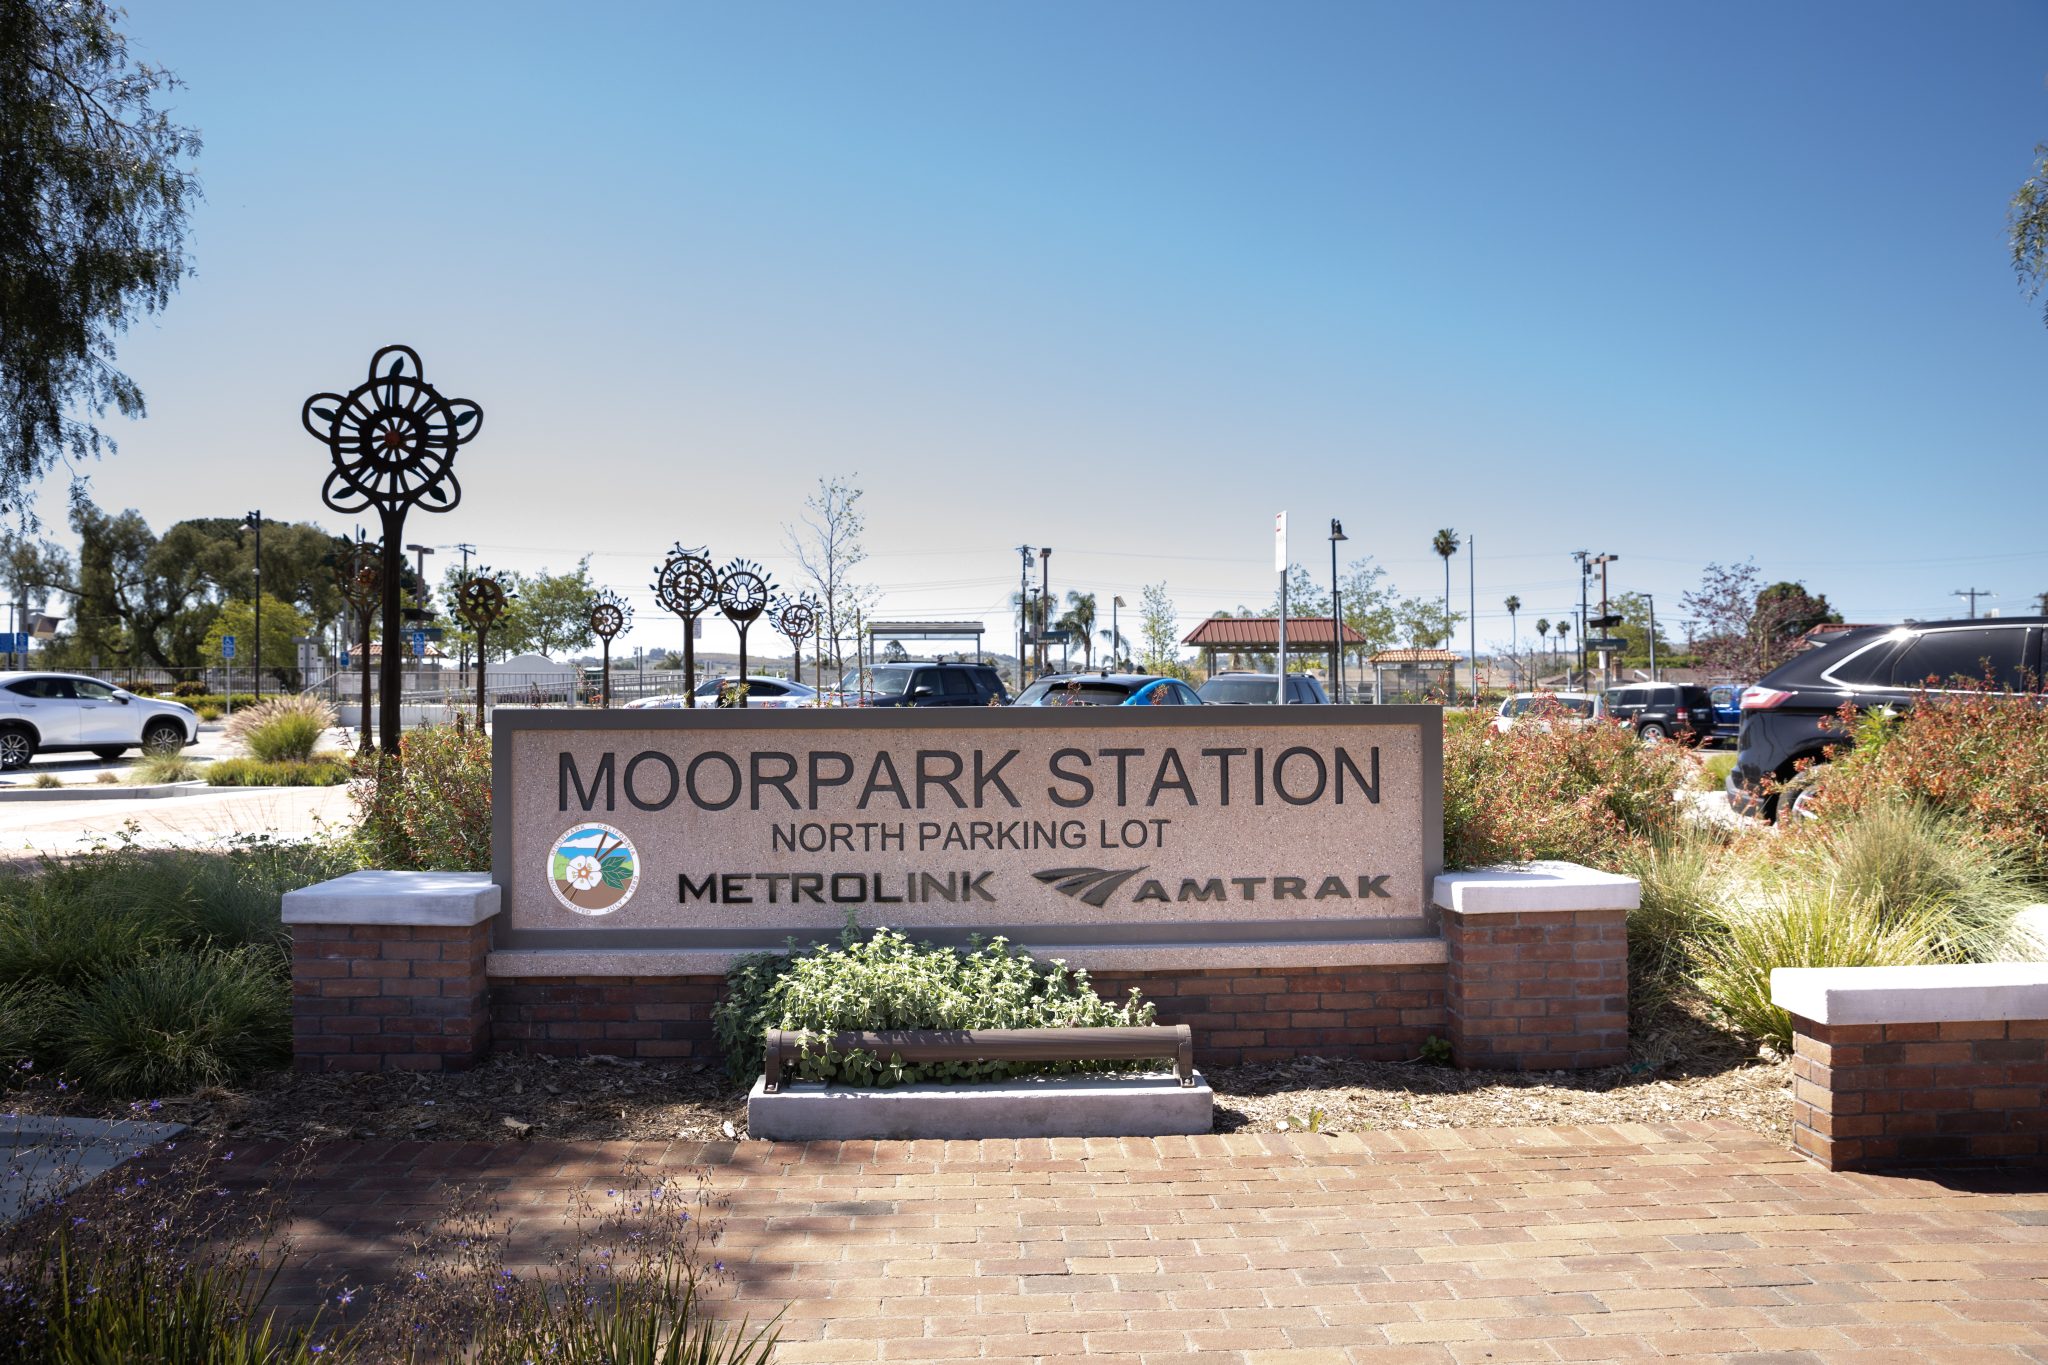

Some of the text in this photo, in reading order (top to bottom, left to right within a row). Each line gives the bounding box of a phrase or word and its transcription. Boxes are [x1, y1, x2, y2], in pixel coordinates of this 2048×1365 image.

[559, 747, 1381, 812] MOORPARK STATION
[551, 824, 635, 856] MOORPARK CALIFORNIA
[773, 819, 1171, 853] NORTH PARKING LOT
[549, 876, 592, 915] INCORPORATED
[606, 900, 622, 913] JULY
[679, 872, 996, 905] METROLINK
[1132, 874, 1391, 903] AMTRAK
